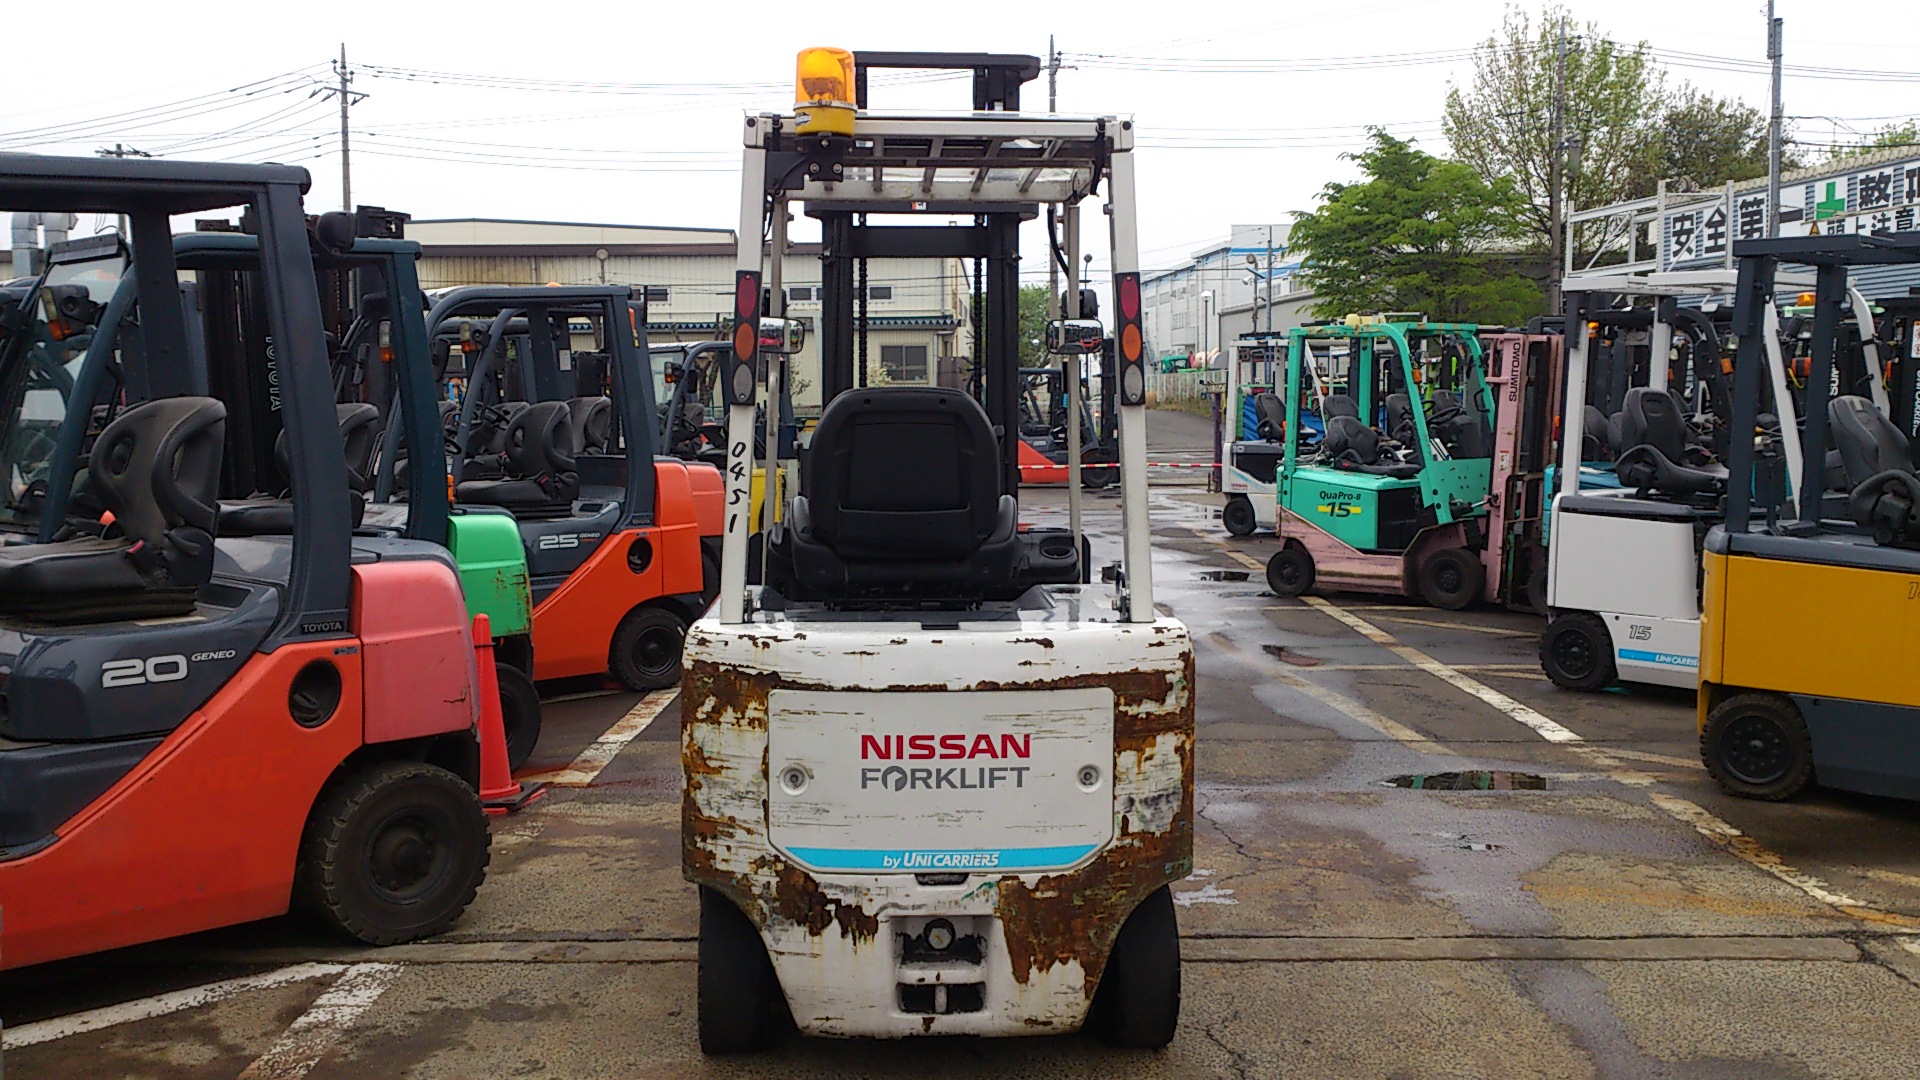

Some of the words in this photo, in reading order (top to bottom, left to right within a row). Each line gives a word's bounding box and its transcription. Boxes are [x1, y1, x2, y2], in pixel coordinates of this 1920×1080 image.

[1509, 342, 1521, 402] SUMITOMO
[1327, 502, 1351, 518] 15
[540, 534, 579, 549] 25
[1908, 581, 1920, 600] 1
[303, 621, 343, 633] TOYOTA
[1629, 624, 1652, 640] 15
[102, 655, 188, 688] 20
[191, 650, 237, 661] GENEO
[1655, 654, 1699, 667] UNICARRIE
[861, 734, 1031, 760] NISSAN
[861, 765, 1031, 792] FORKLIFT
[883, 855, 901, 869] by
[903, 852, 999, 867] UNICARRIERS
